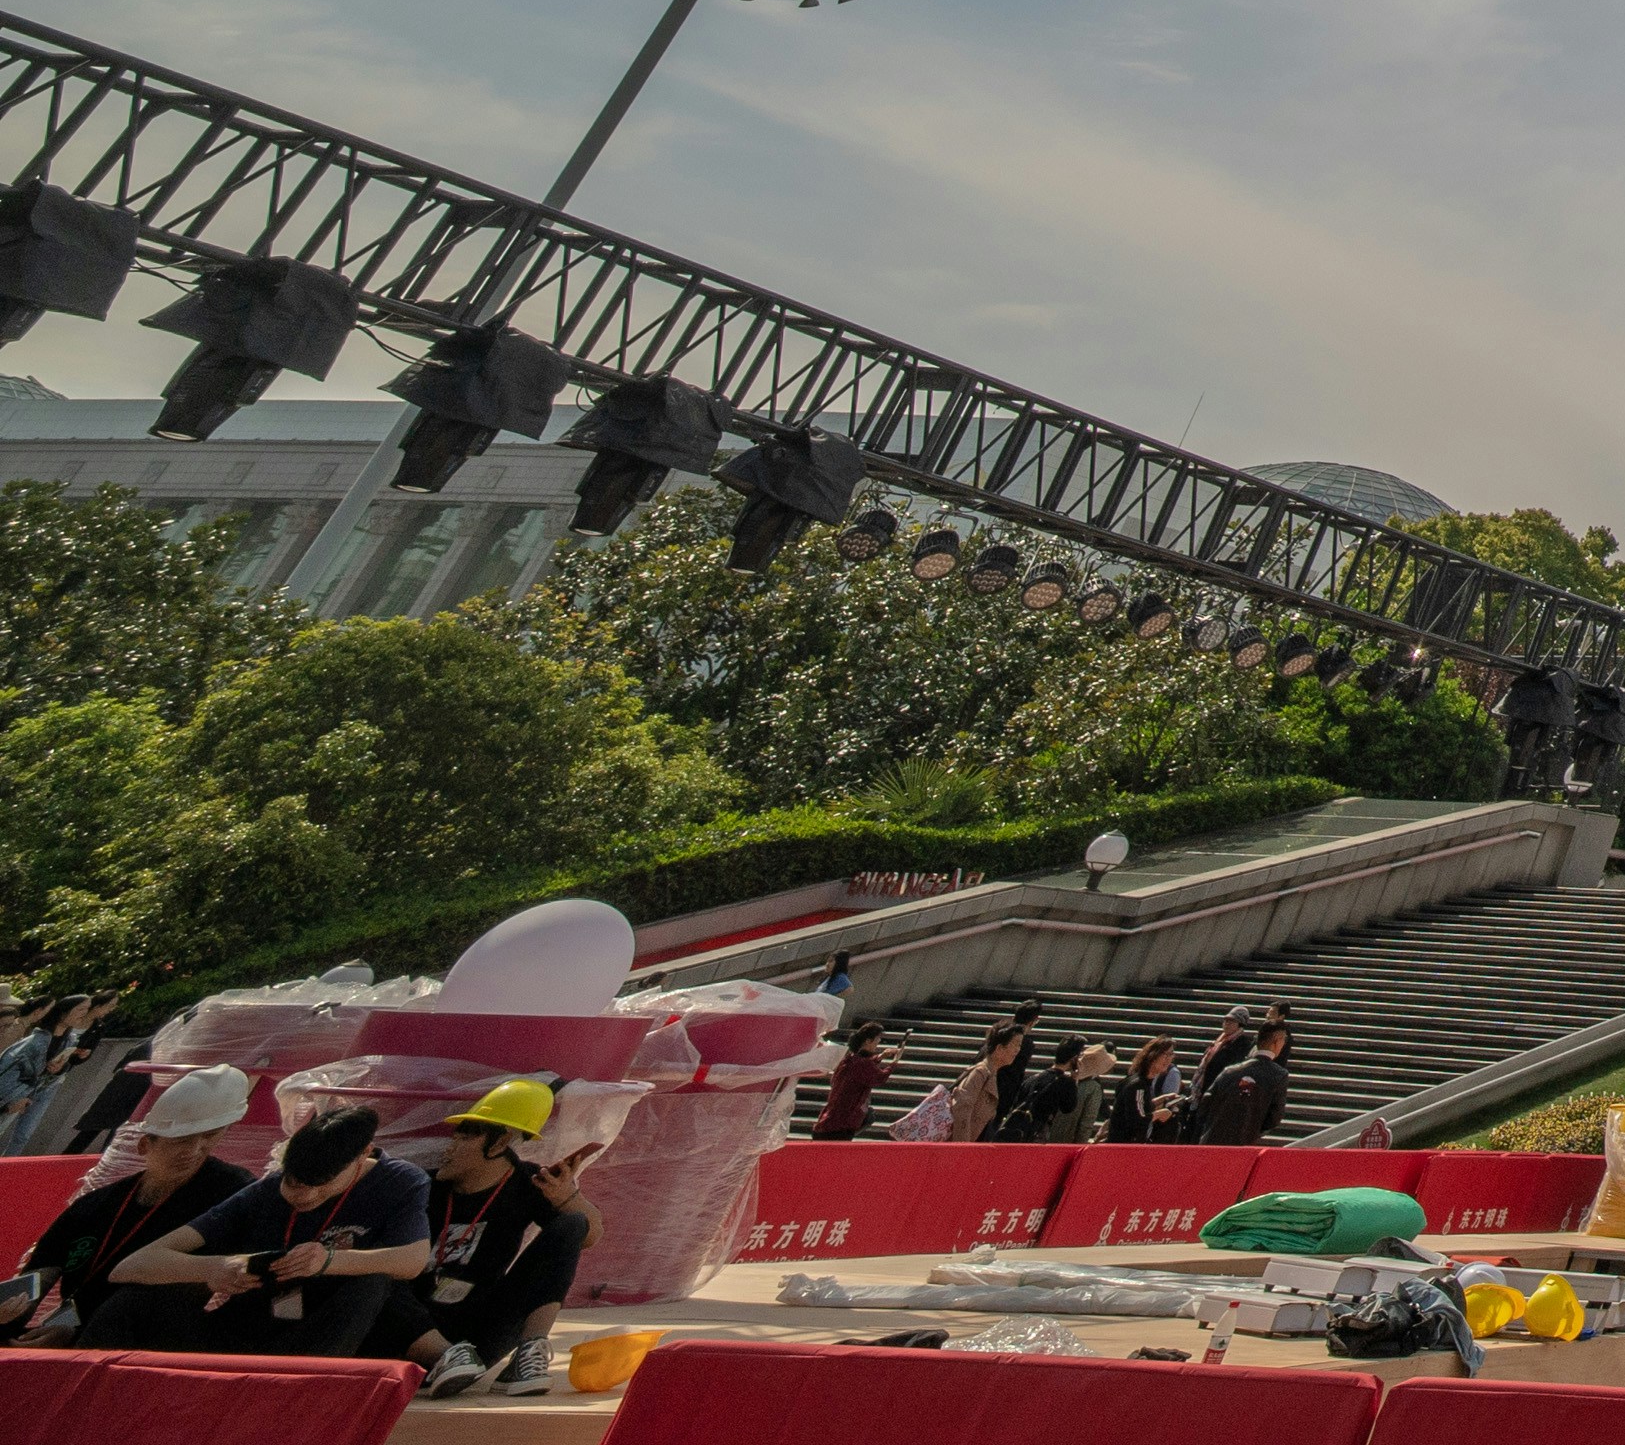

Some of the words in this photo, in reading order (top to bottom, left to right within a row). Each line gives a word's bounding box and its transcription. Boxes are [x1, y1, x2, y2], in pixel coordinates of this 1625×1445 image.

[1123, 1208, 1197, 1233] 东方明珠
[1458, 1207, 1509, 1229] 东方明珠
[744, 1218, 852, 1250] 东方明珠
